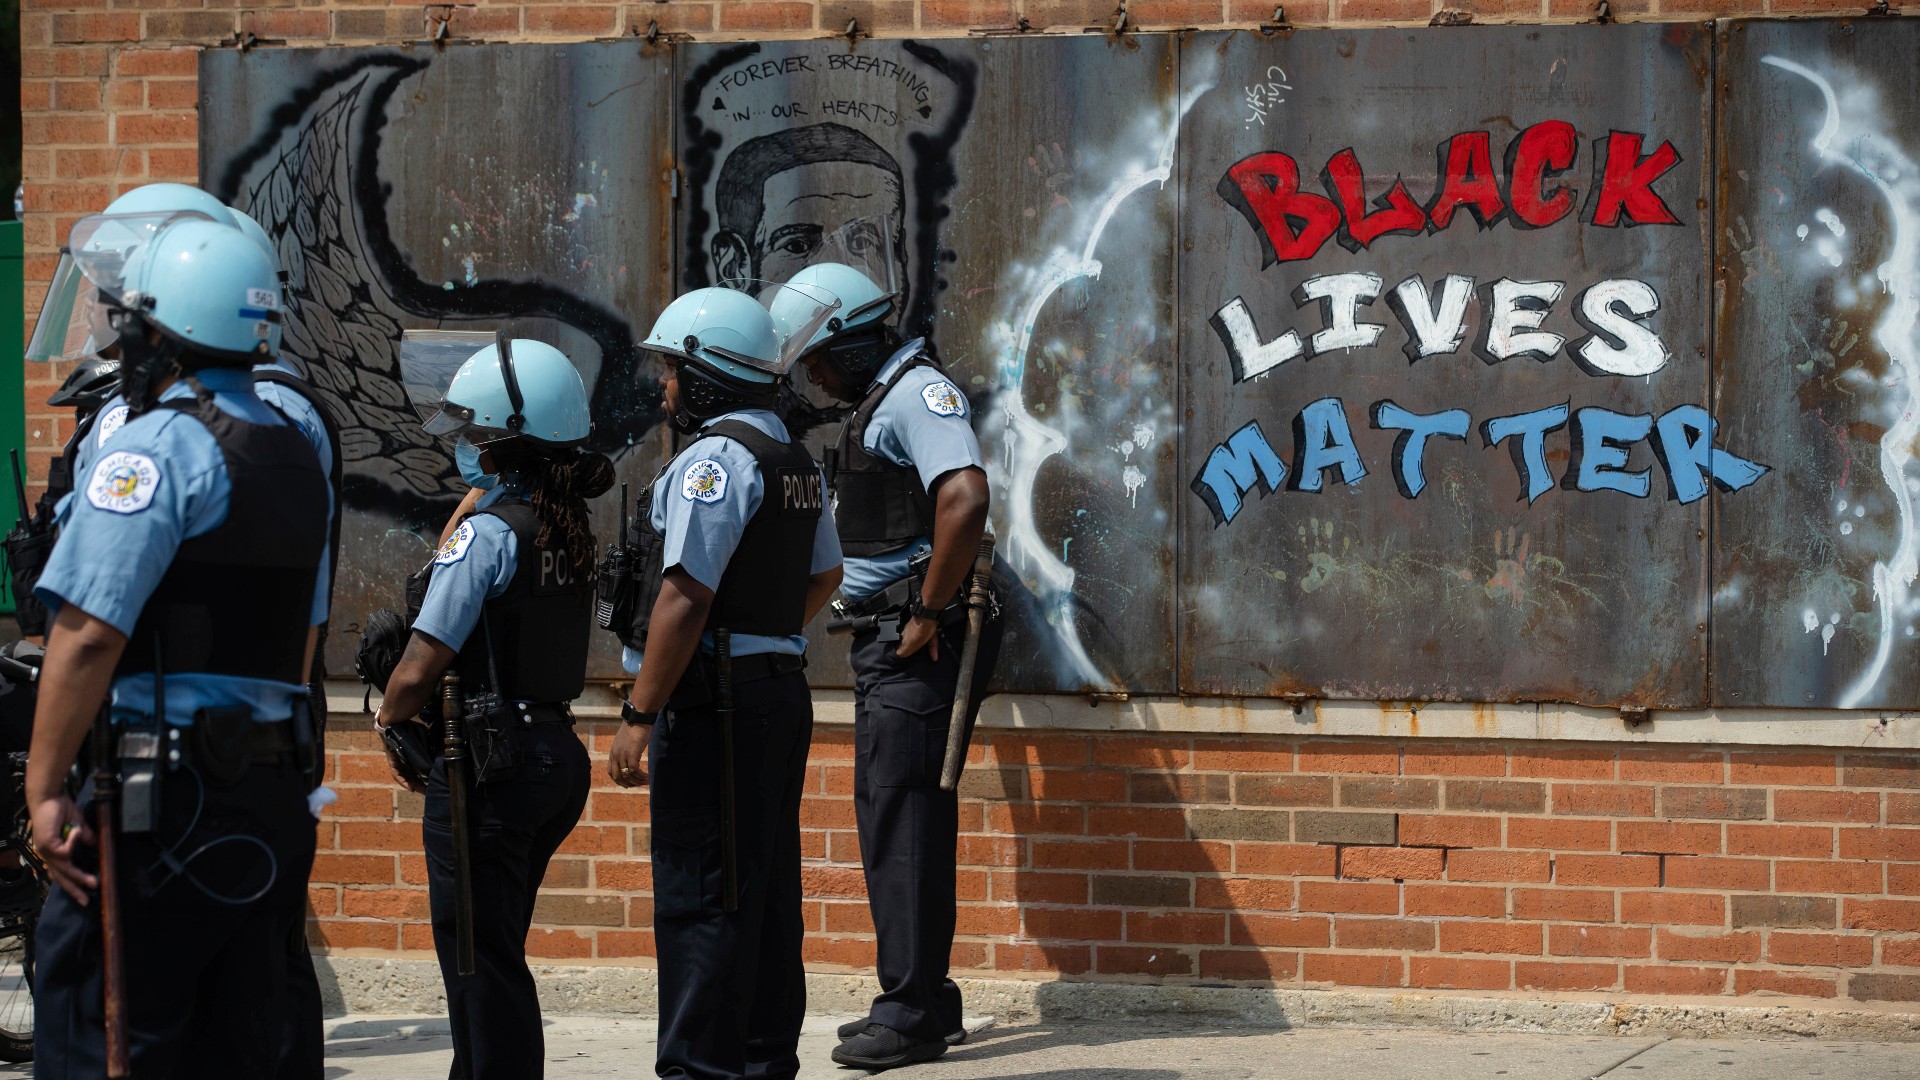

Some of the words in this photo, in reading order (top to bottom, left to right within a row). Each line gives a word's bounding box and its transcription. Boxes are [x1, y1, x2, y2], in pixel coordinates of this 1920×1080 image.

[719, 55, 815, 92] FOREVER
[828, 54, 930, 105] BREATHING
[771, 102, 808, 118] OUR
[1216, 119, 1686, 271] BLACK
[1209, 271, 1672, 385] LIVES
[95, 361, 120, 376] POLIC
[103, 408, 129, 430] CHIC
[99, 455, 152, 486] CHICAGO
[687, 461, 722, 482] CHICAGO
[1190, 395, 1776, 530] MATTER
[96, 485, 141, 508] POLICE
[686, 486, 718, 498] POLICE
[783, 474, 821, 509] POLICE
